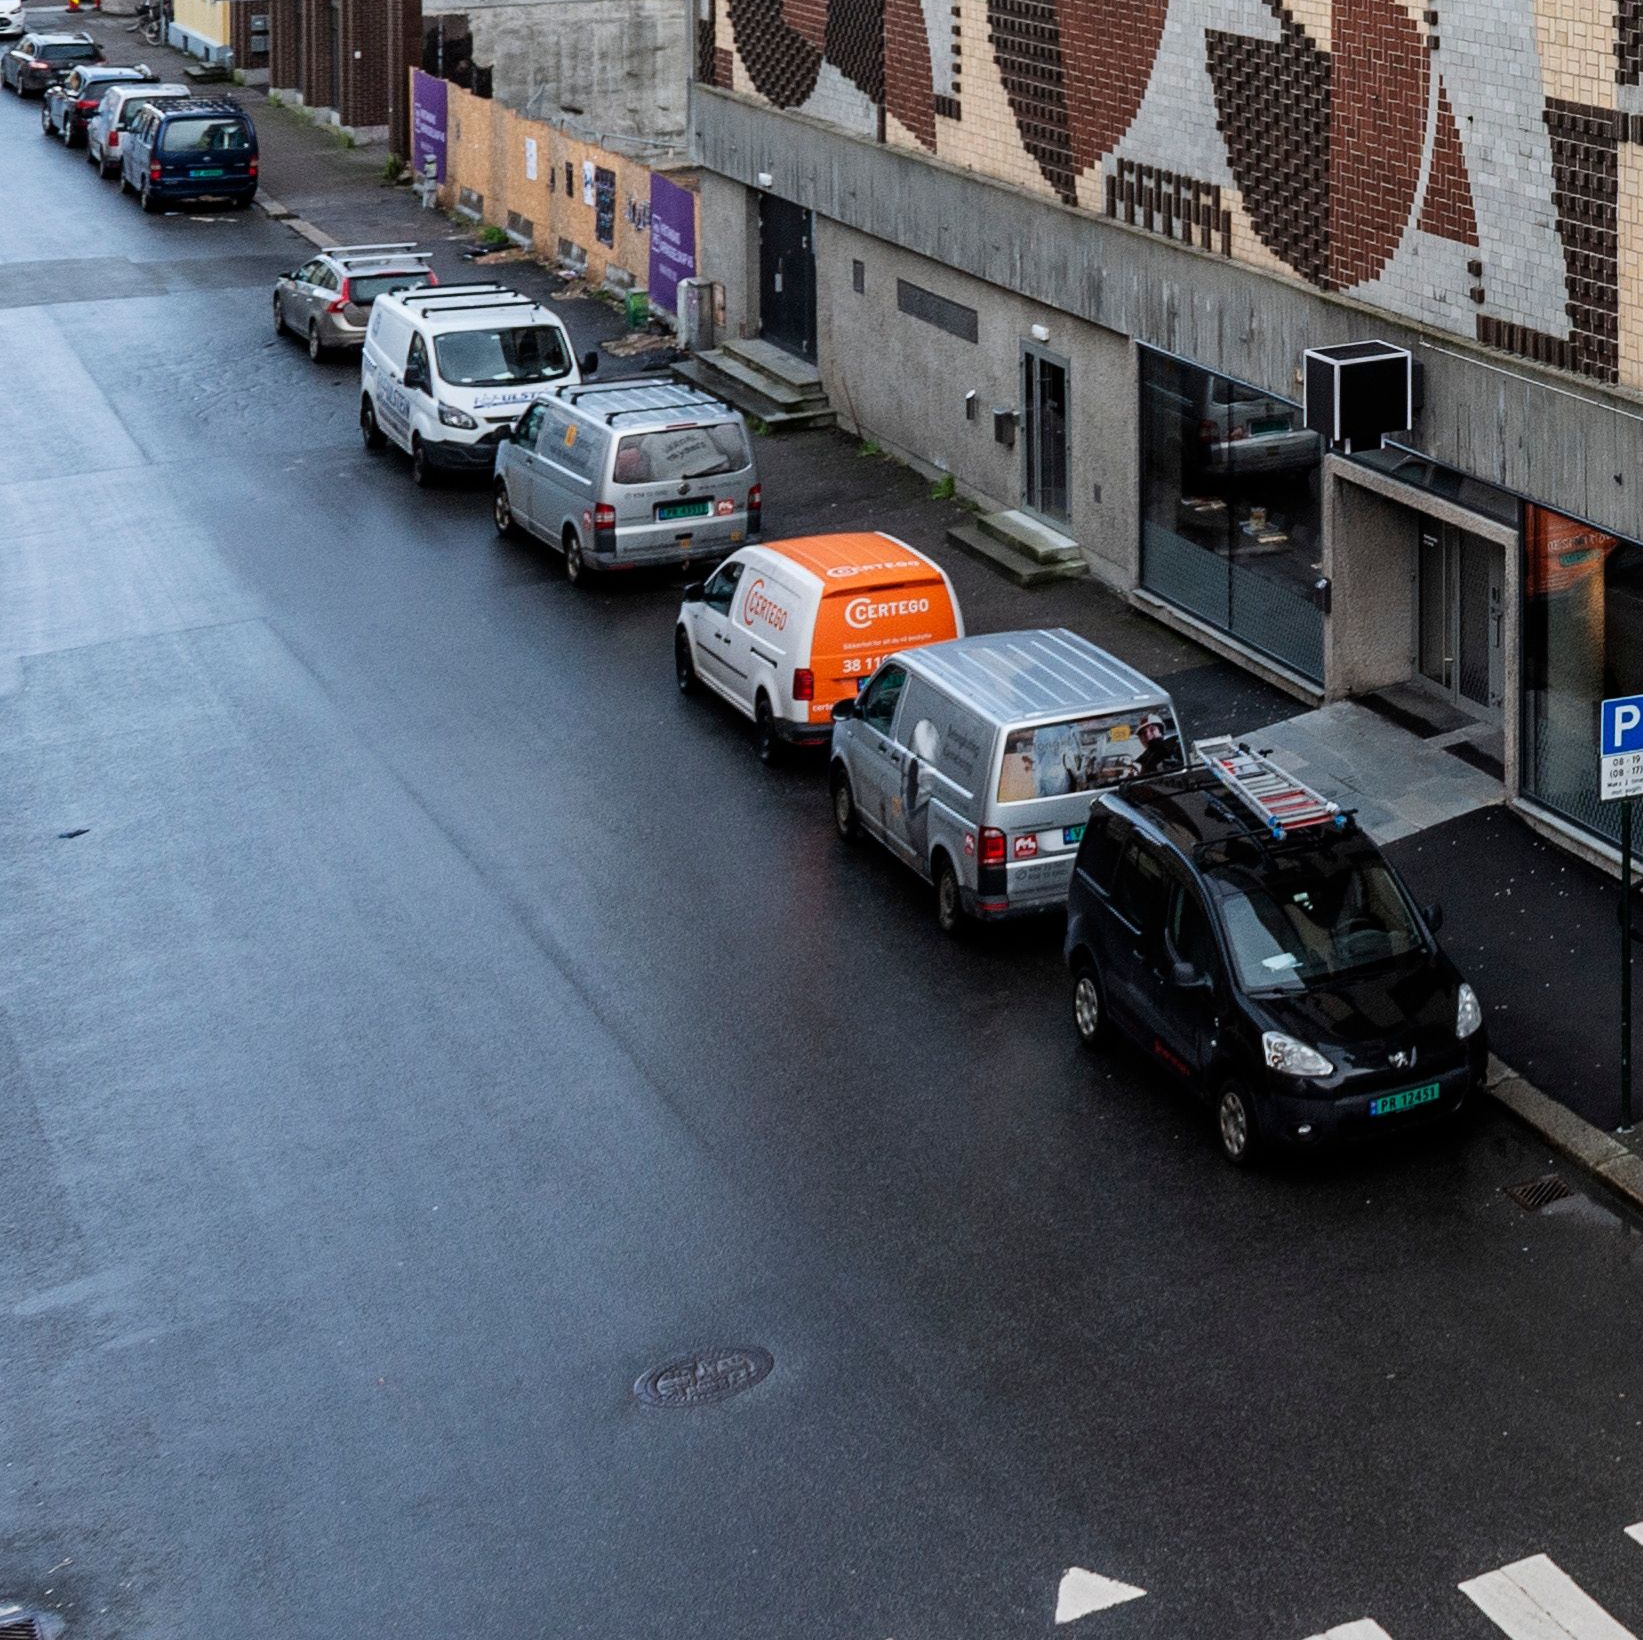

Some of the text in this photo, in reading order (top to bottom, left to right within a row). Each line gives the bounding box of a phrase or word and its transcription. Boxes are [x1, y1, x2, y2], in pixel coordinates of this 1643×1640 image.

[748, 586, 788, 631] CERTEGO
[850, 598, 929, 622] CERTEGO
[843, 659, 861, 674] 38
[1614, 705, 1641, 747] P
[1632, 755, 1641, 764] 19
[1381, 1087, 1437, 1111] PR 12451
